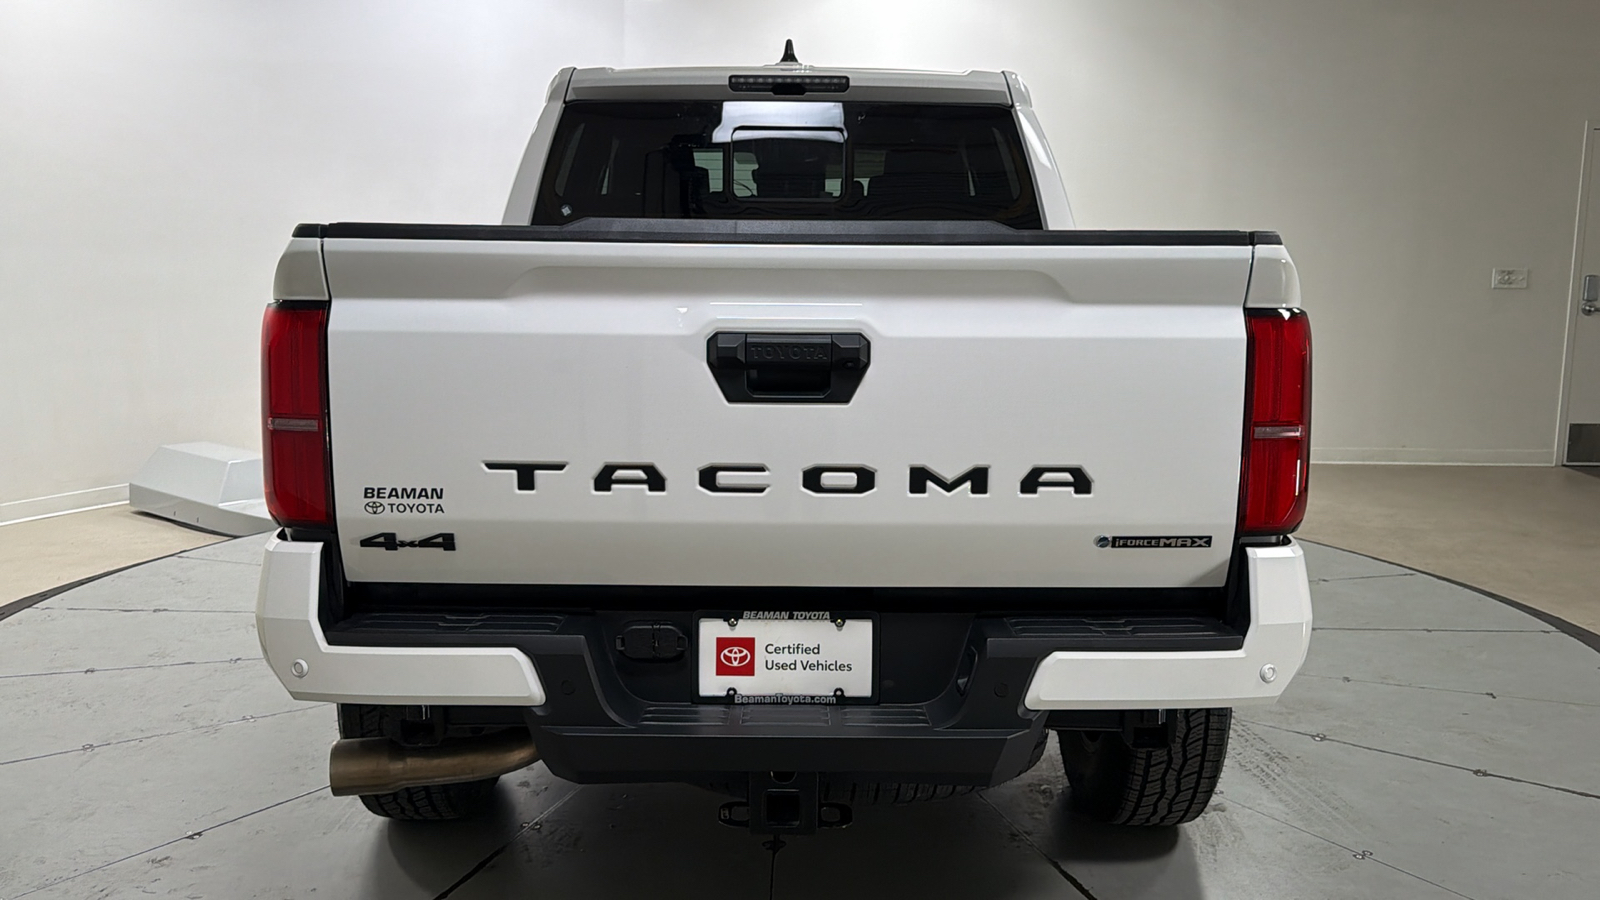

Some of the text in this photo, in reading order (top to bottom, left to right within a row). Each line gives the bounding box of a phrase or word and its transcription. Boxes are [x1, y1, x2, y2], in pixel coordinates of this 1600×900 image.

[750, 345, 828, 360] TOYOTA
[482, 461, 1094, 496] TACOMA
[363, 487, 444, 499] BEAMAN
[387, 503, 445, 514] TOYOTA
[743, 611, 830, 620] BEAMAN TOYOTA
[765, 643, 821, 655] Certified
[765, 660, 852, 672] Used Vehicles
[734, 693, 837, 705] BeamanToyota.com
